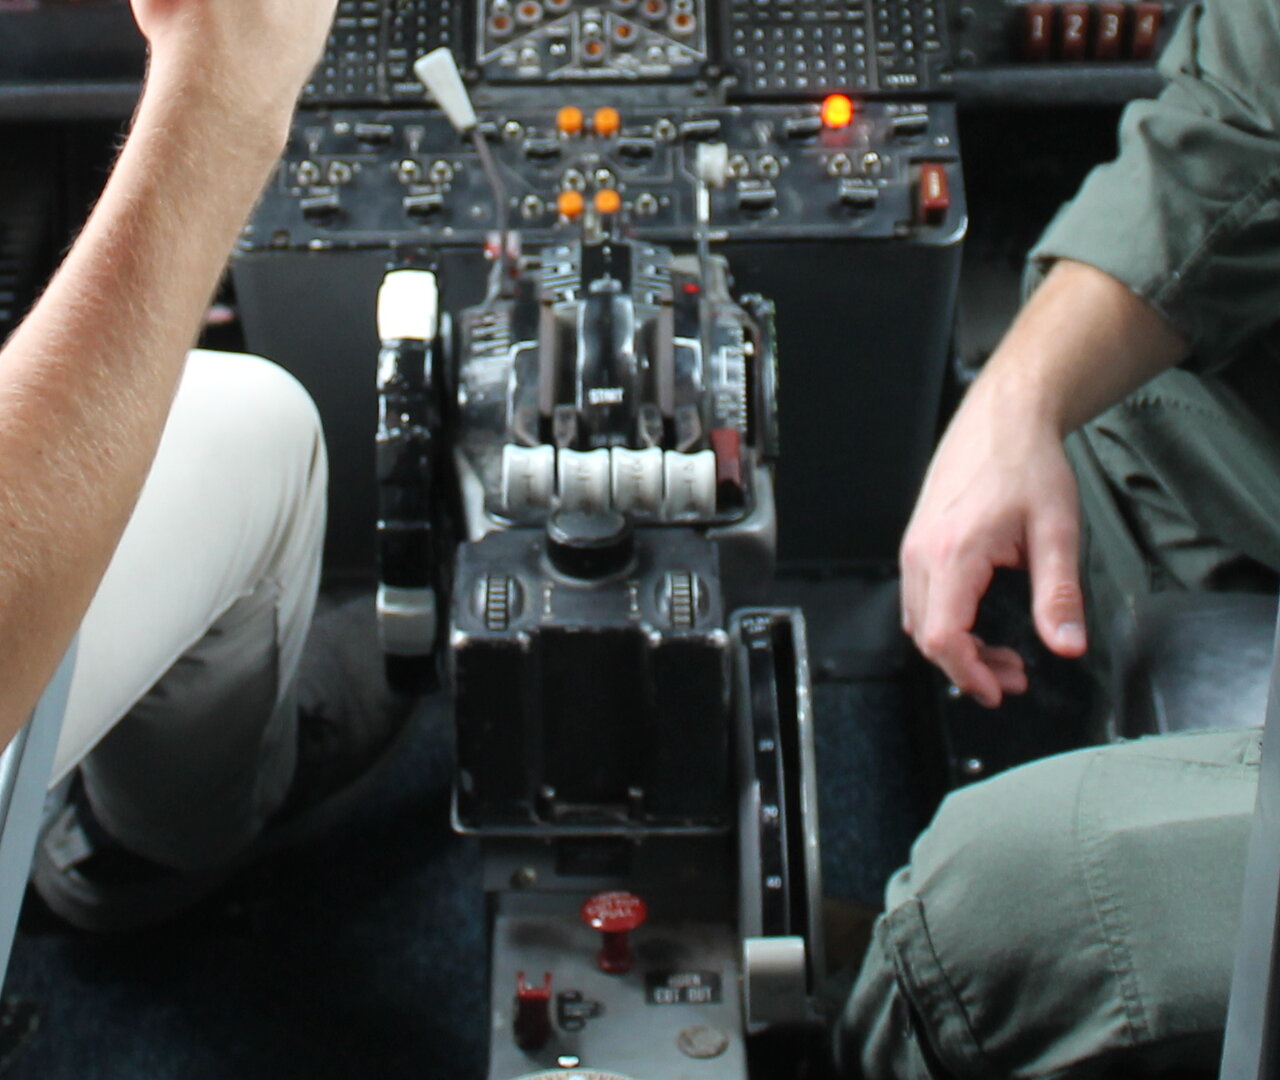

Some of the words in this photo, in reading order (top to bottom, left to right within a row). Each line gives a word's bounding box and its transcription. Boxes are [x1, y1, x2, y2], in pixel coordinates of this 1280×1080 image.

[1031, 15, 1044, 39] 1
[1066, 14, 1083, 39] 2
[1103, 14, 1120, 38] 3
[654, 988, 680, 1004] CUT
[687, 987, 712, 1003] OUT
